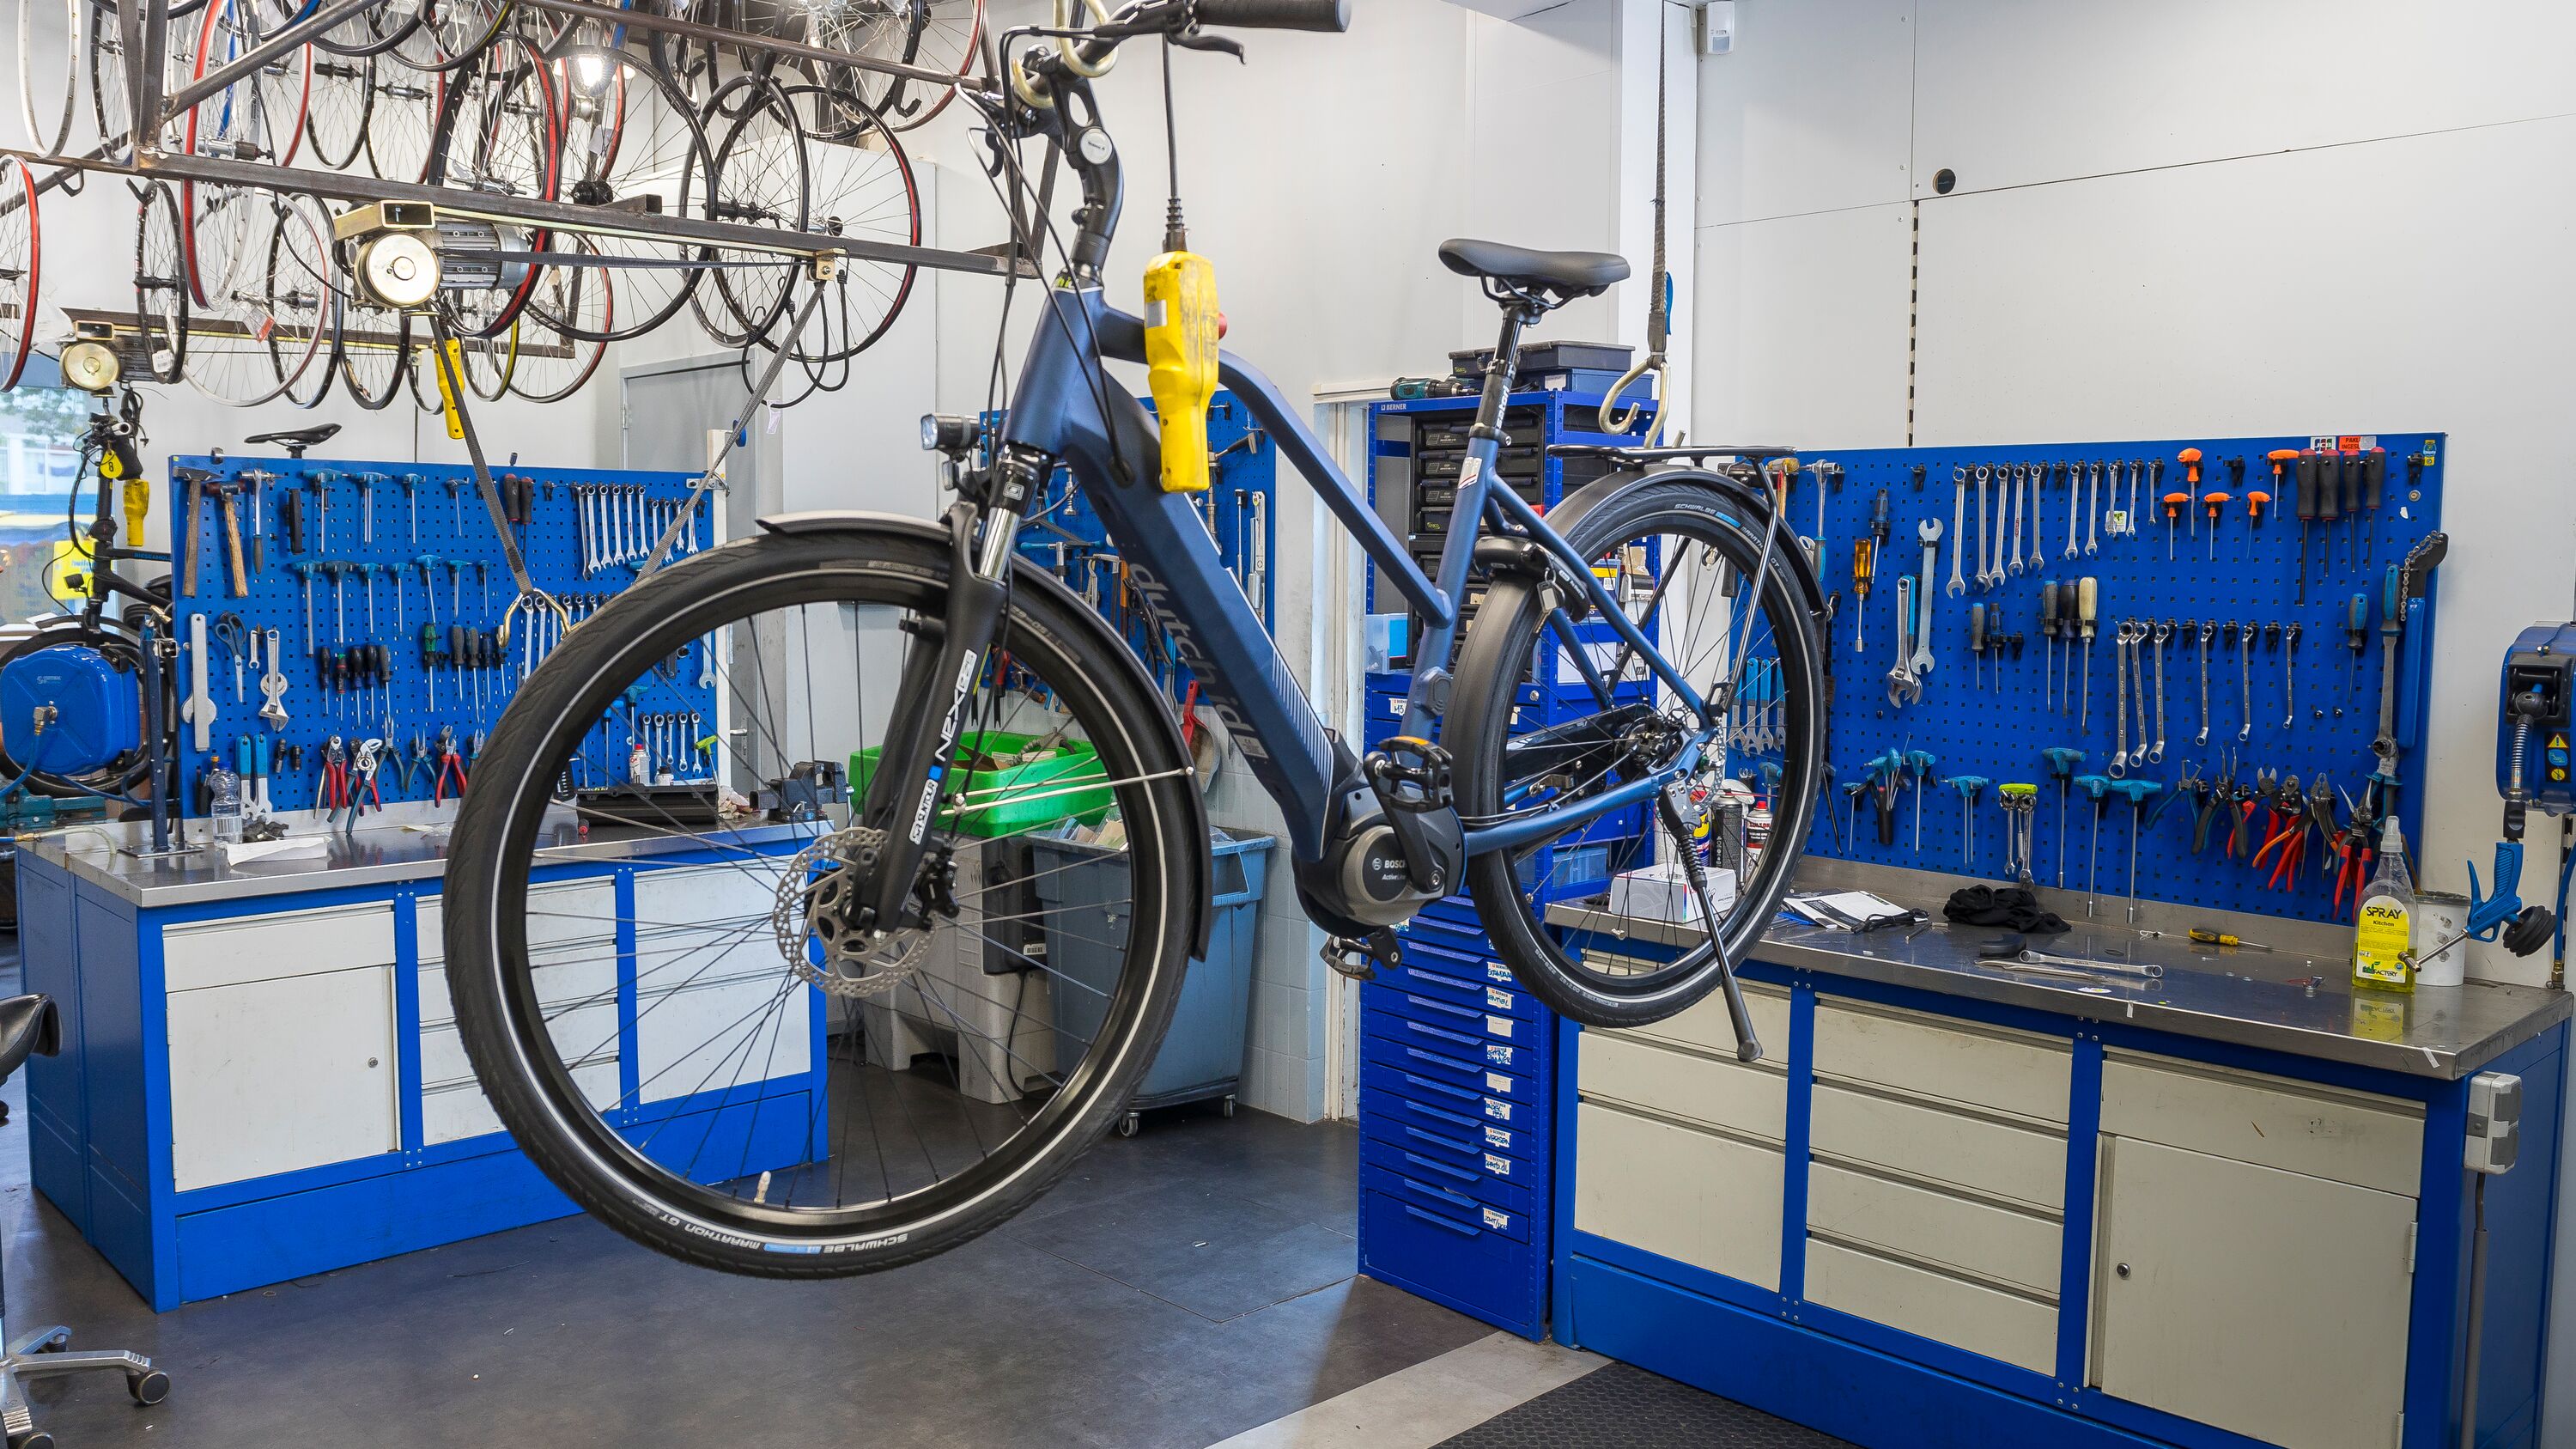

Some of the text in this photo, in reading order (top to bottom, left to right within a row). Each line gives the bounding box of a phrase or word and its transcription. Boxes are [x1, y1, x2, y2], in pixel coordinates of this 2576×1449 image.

[108, 461, 114, 472] 8
[1674, 503, 1716, 514] SCHWALBE
[1129, 563, 1256, 734] dutch id
[2366, 906, 2402, 919] SPRAY
[659, 1215, 679, 1227] GT
[684, 1224, 761, 1250] MARATHON
[823, 1233, 908, 1253] SCHWALBE
